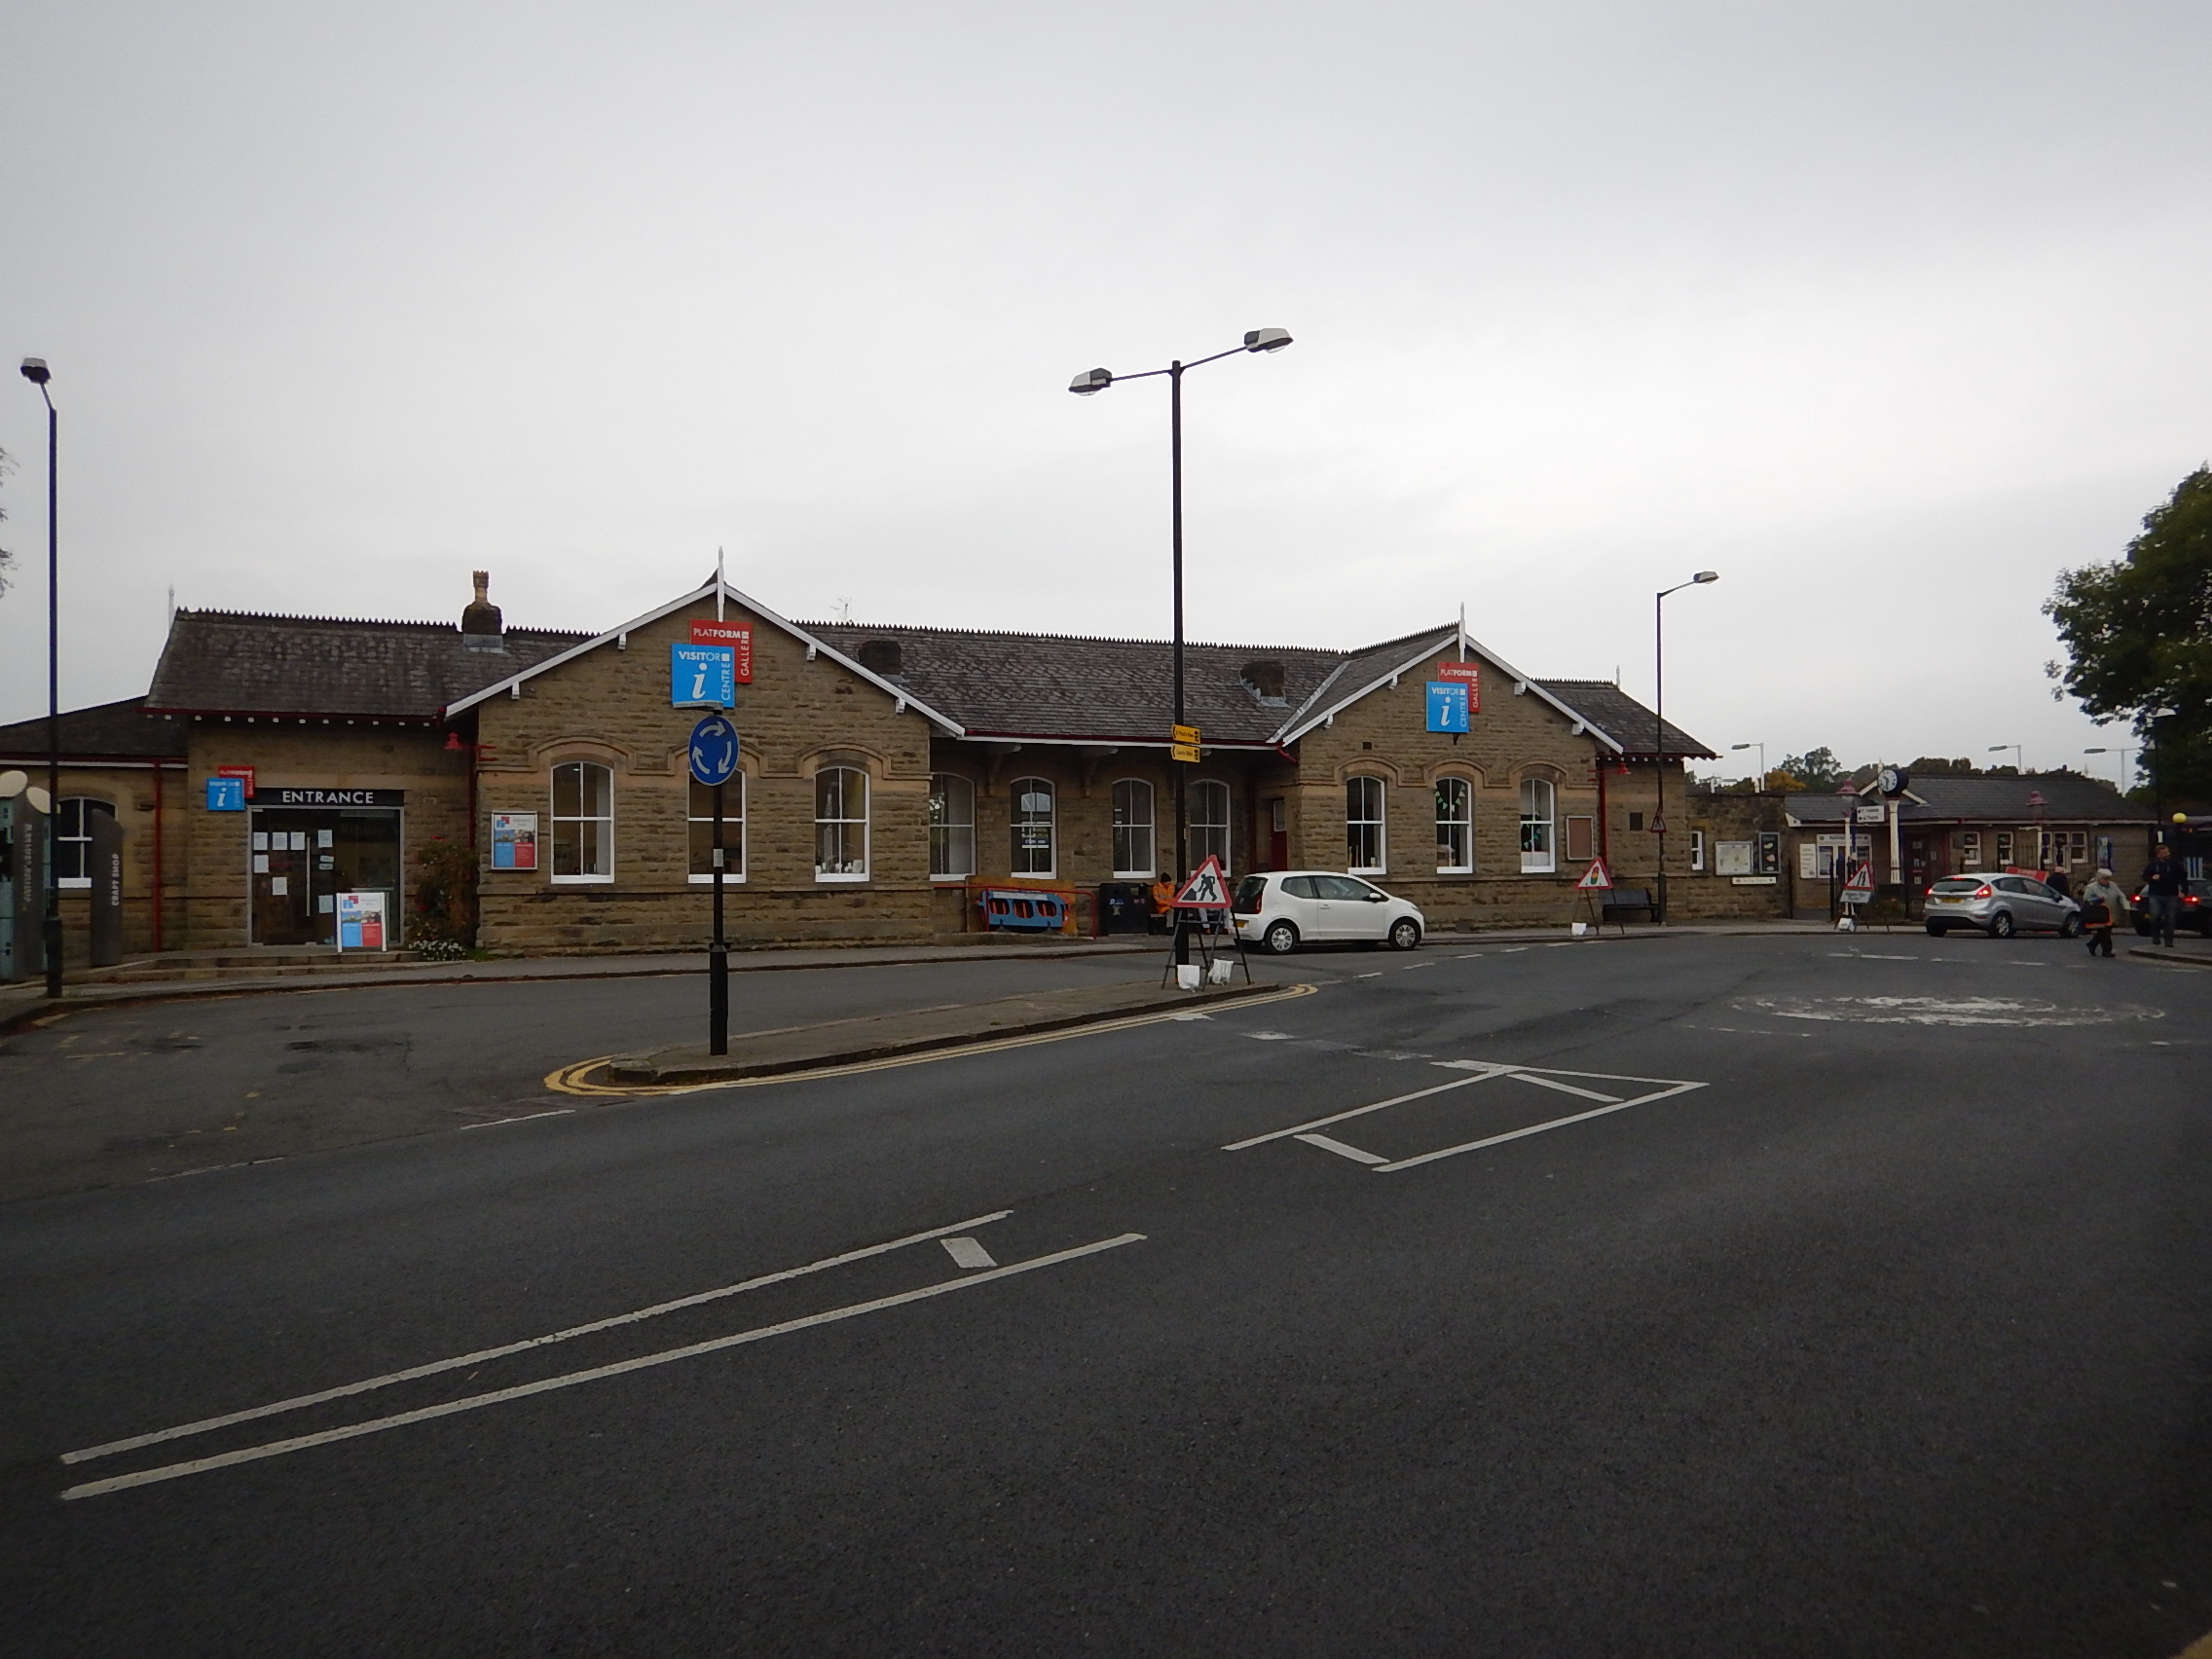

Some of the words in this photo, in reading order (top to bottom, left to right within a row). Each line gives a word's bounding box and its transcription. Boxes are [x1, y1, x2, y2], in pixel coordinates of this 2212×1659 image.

[693, 628, 740, 638] PLATFORM
[679, 650, 720, 661] VISITOR
[721, 663, 730, 700] CENTRE
[282, 790, 374, 804] ENTRANCE
